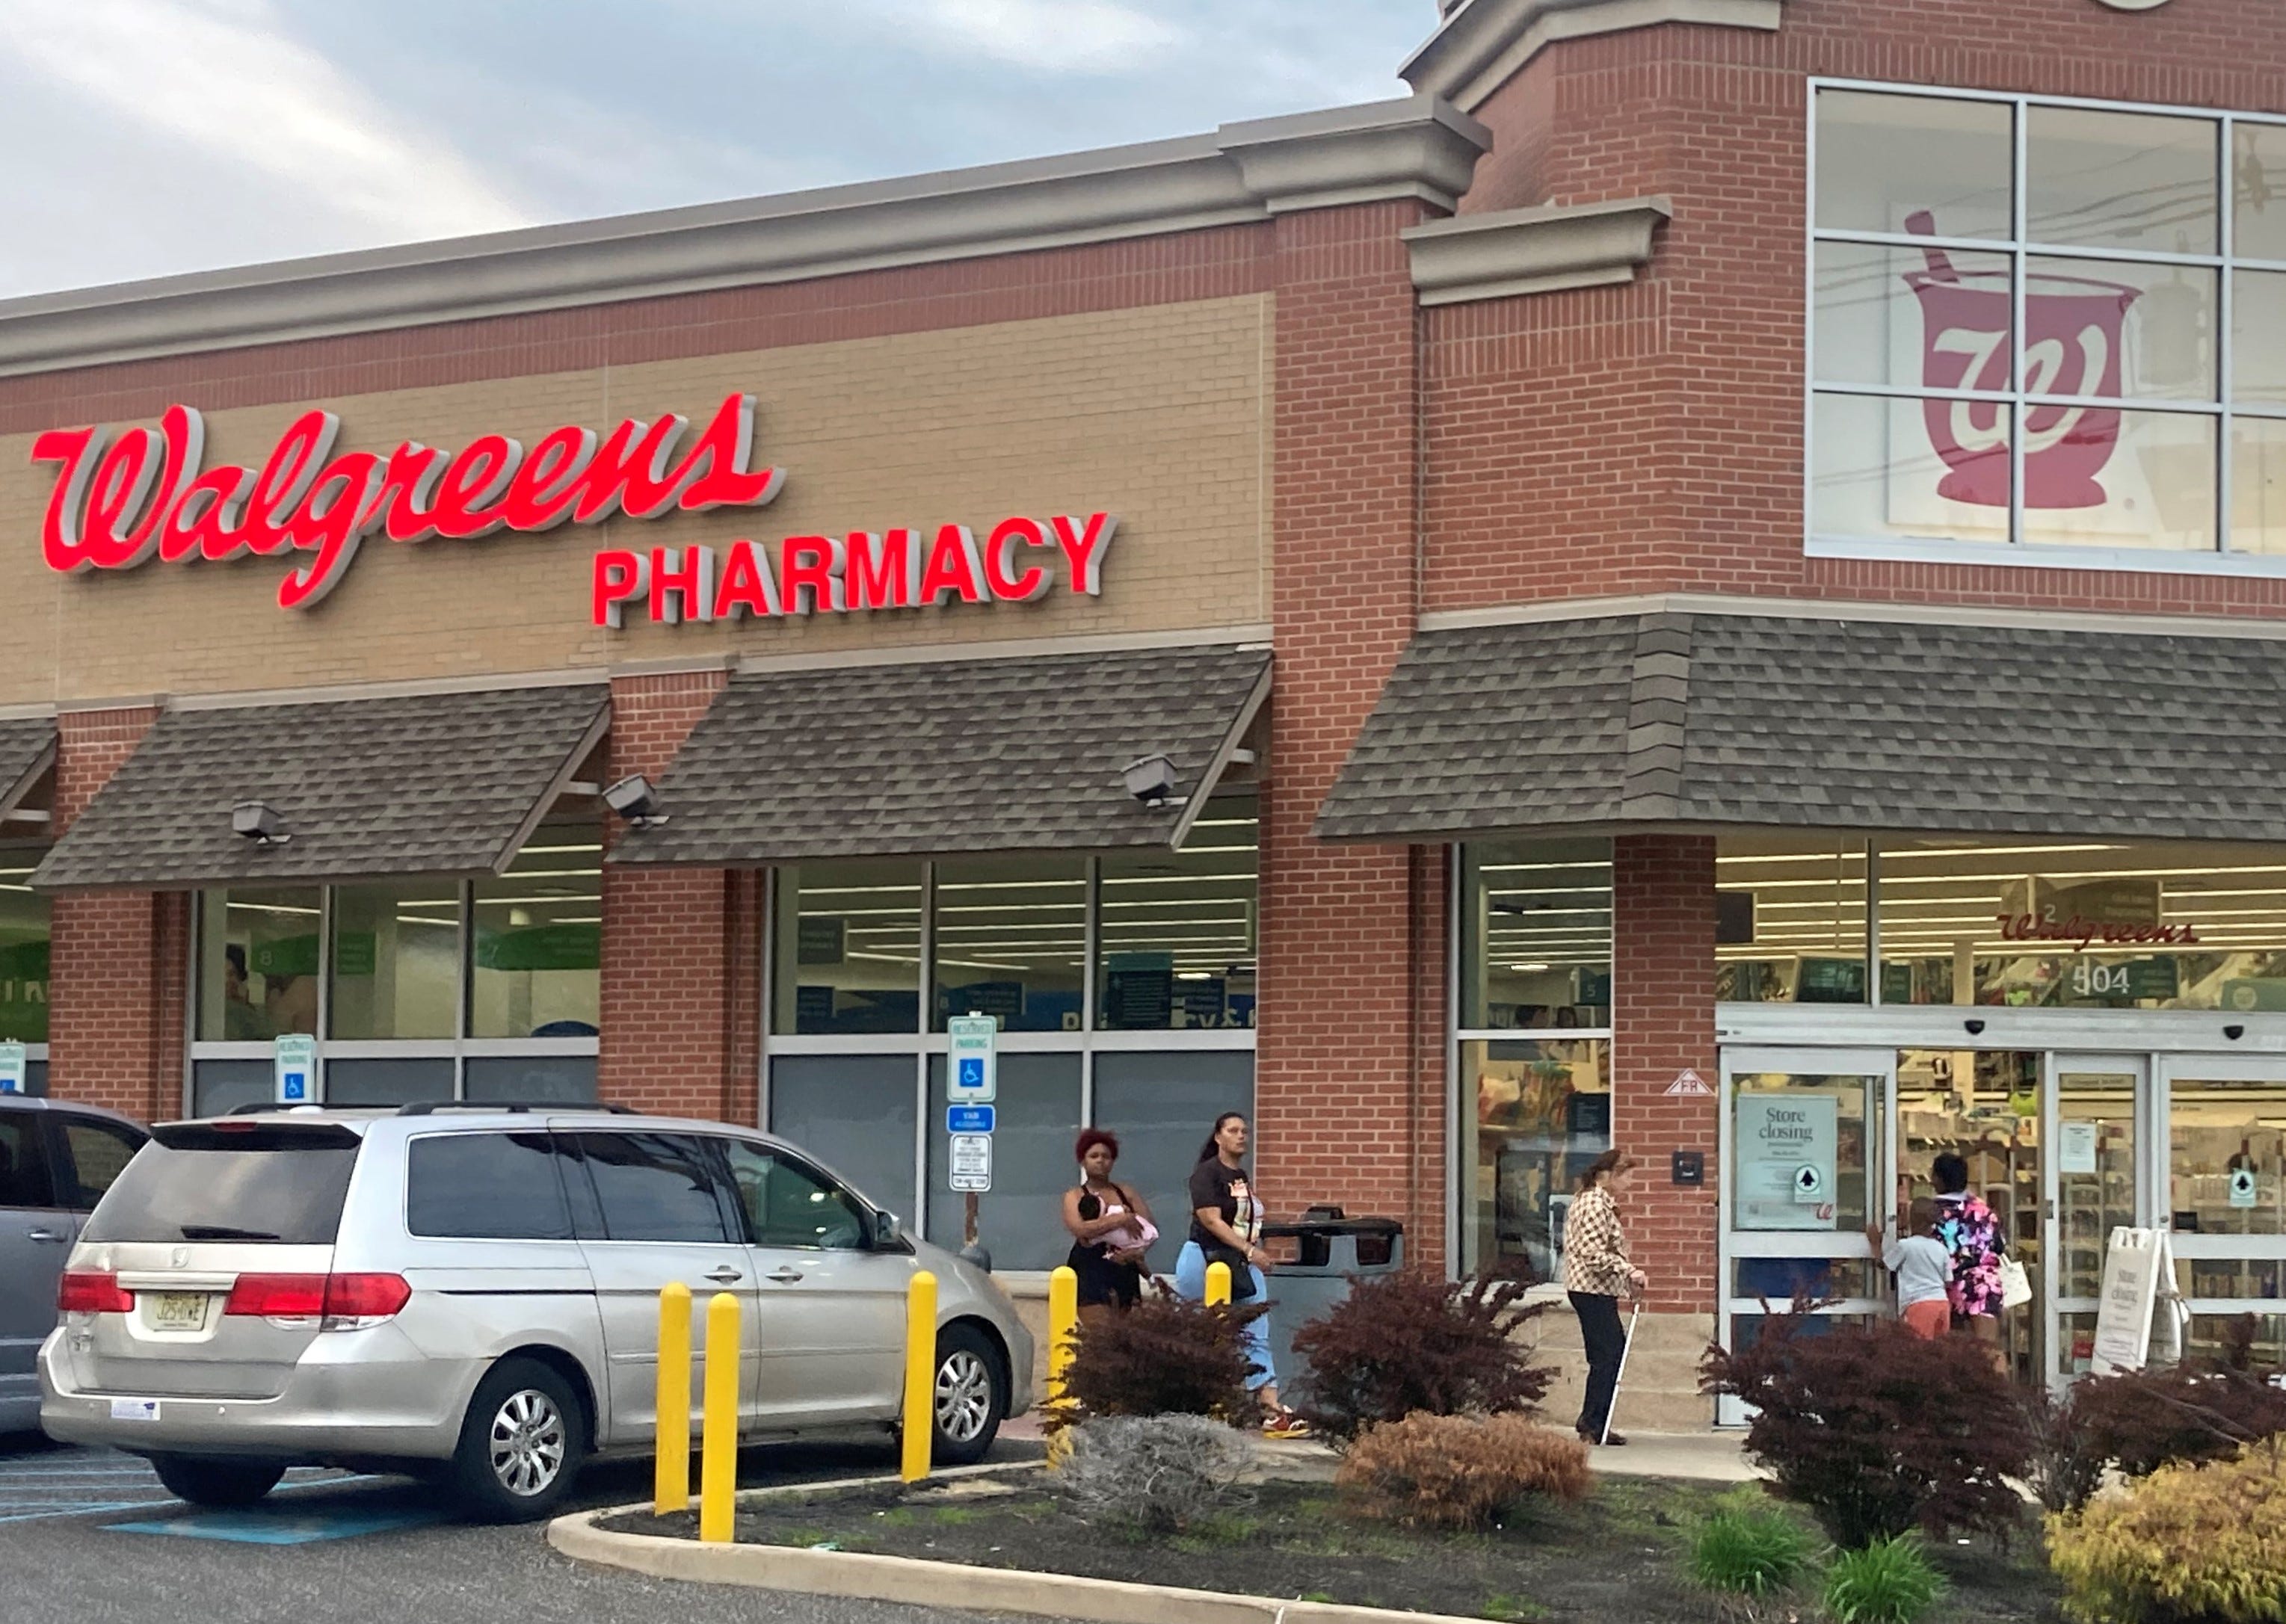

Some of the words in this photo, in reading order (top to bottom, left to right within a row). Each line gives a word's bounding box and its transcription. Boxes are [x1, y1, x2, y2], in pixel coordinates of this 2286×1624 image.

[31, 393, 786, 609] Walgreens
[592, 512, 1115, 629] PHARMACY
[1997, 913, 2199, 952] Walgreens
[2072, 965, 2130, 996] 504
[1681, 1080, 1698, 1092] FR
[1766, 1107, 1806, 1123] Store
[1758, 1123, 1814, 1142] closing
